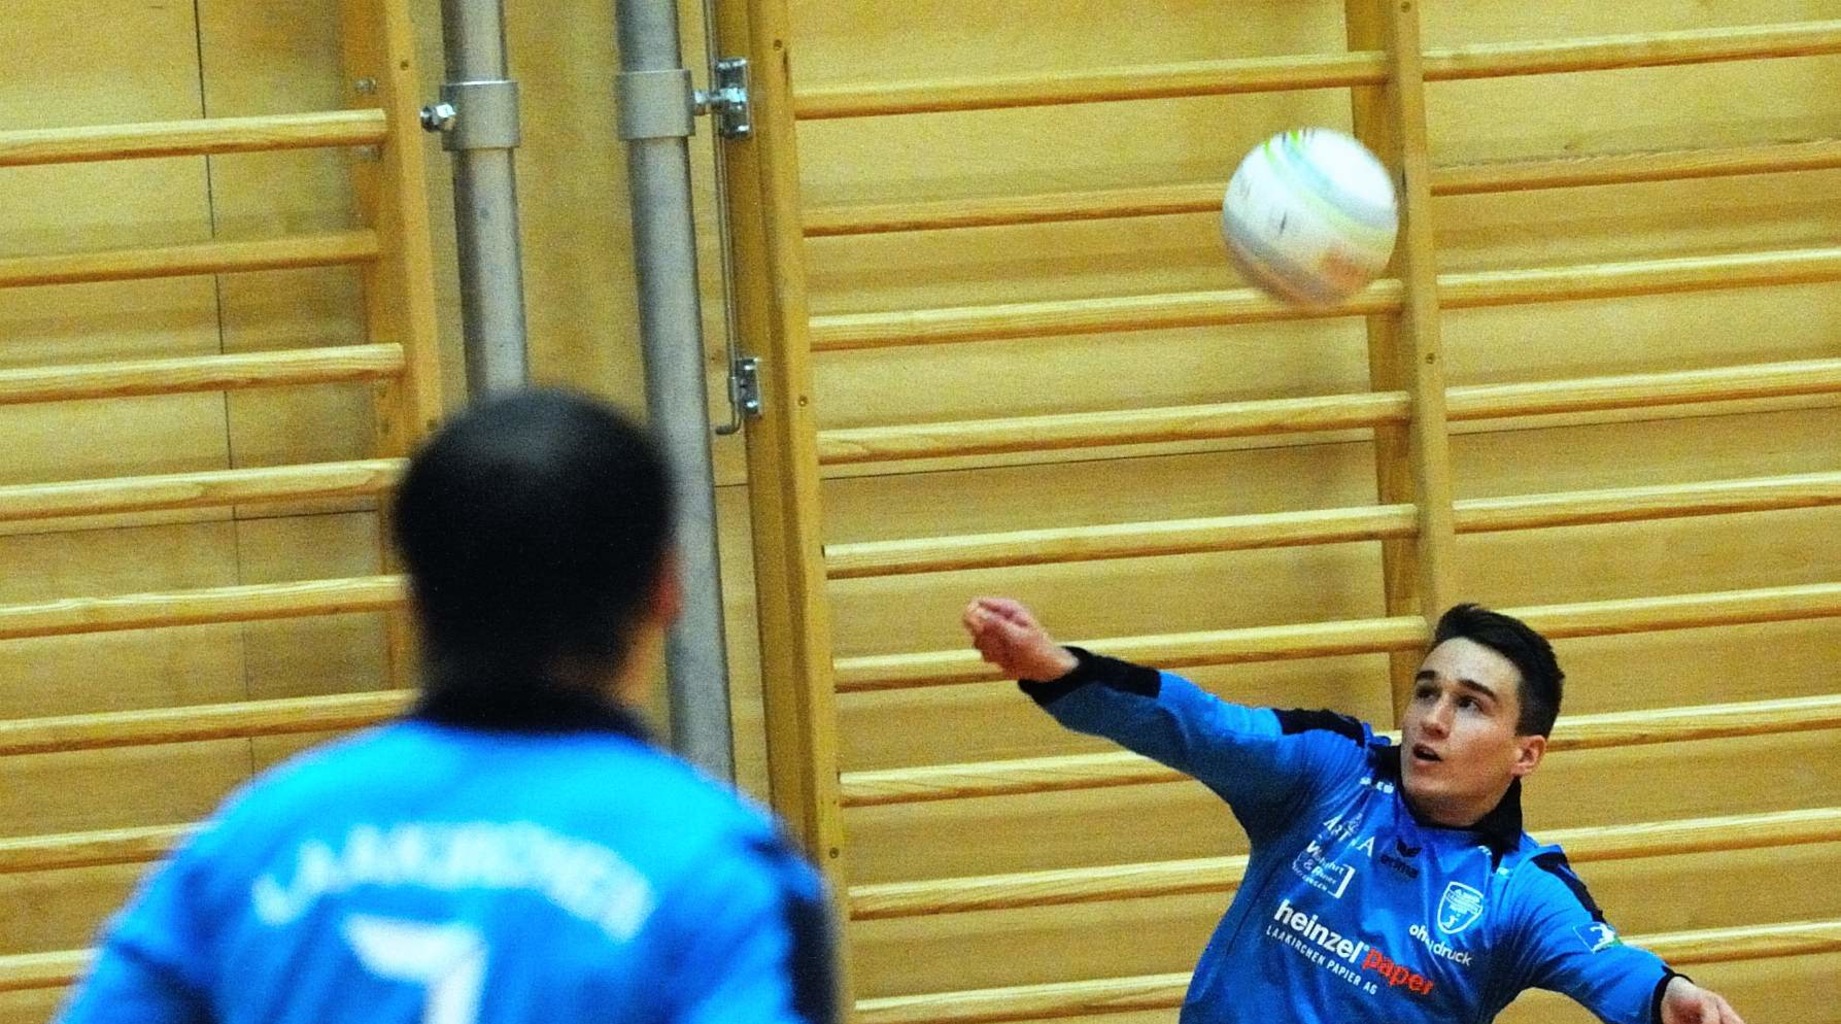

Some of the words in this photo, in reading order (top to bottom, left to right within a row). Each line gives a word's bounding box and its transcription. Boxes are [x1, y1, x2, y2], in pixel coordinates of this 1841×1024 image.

[1266, 924, 1327, 966] LAAKIRCHEN
[1325, 958, 1362, 987] PAPIER
[1362, 980, 1379, 995] AG
[1273, 898, 1365, 964] heinzel
[1361, 948, 1434, 995] paper
